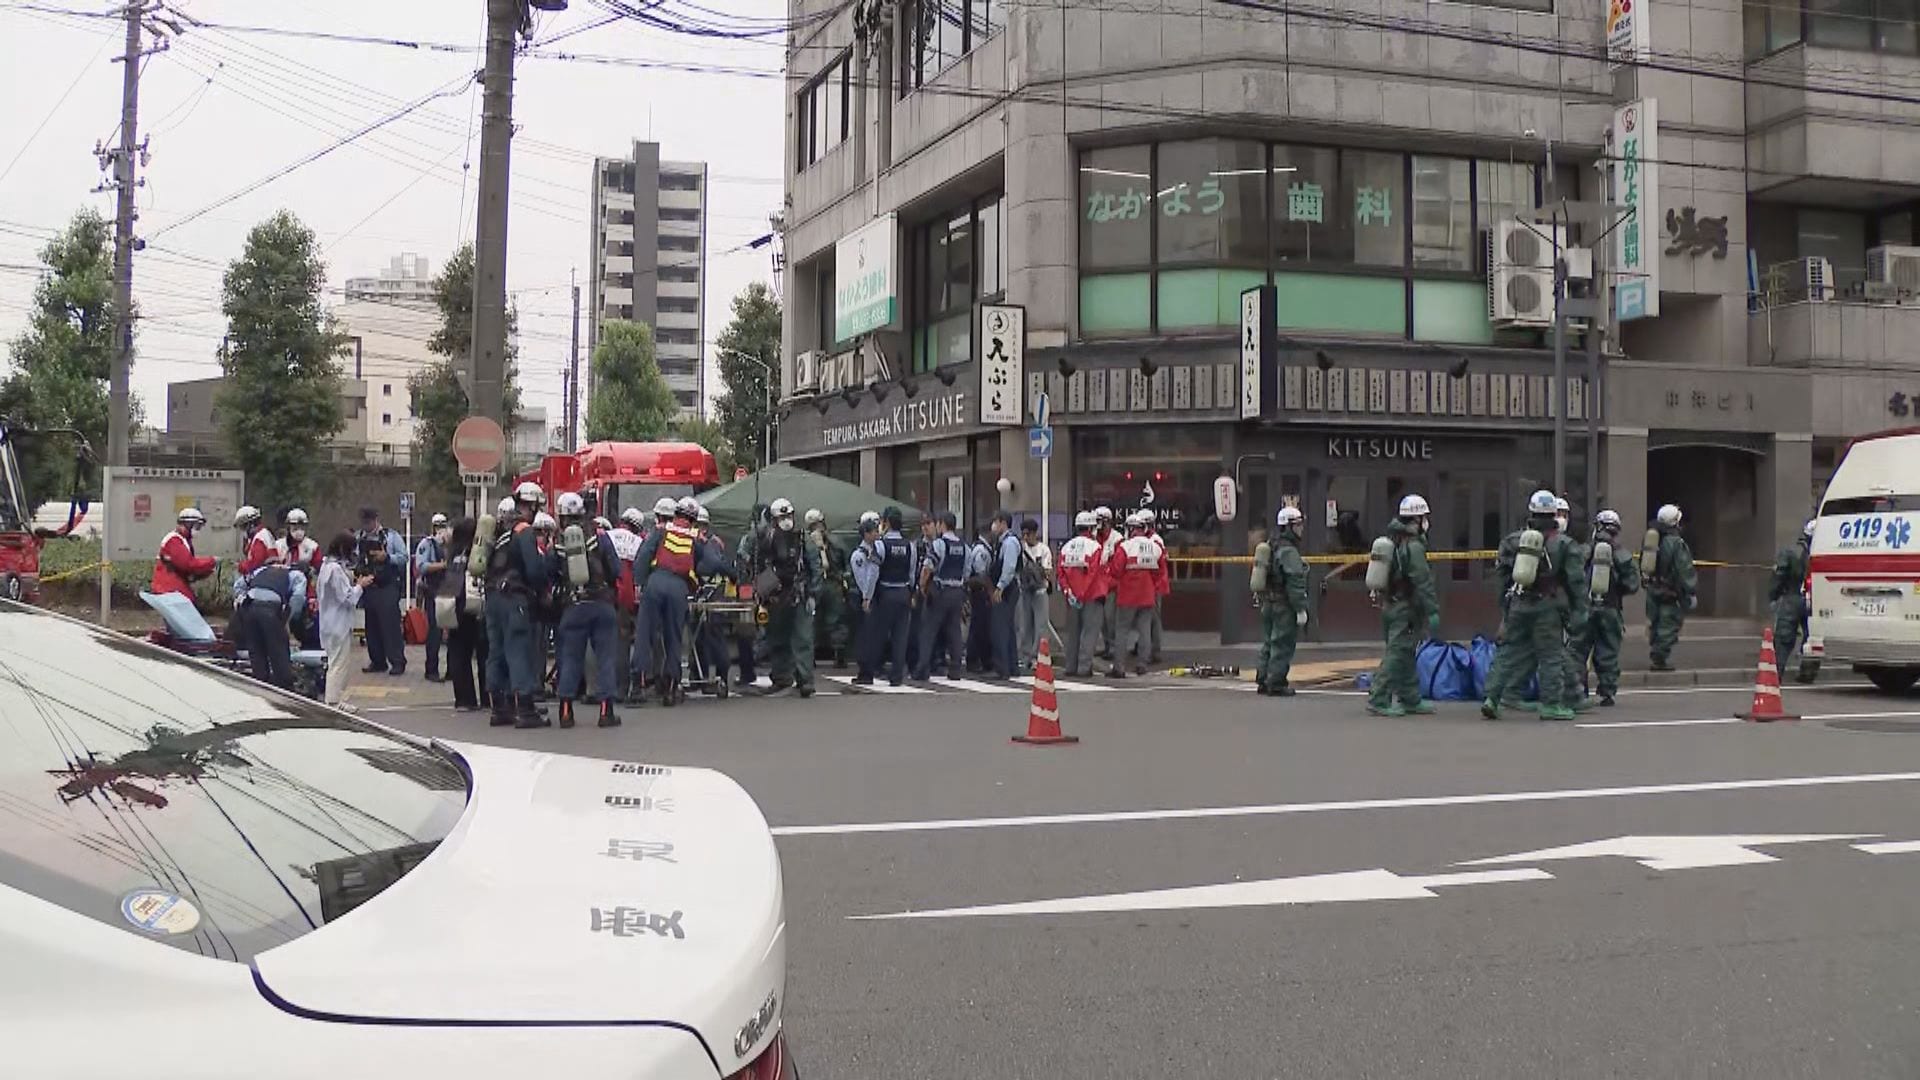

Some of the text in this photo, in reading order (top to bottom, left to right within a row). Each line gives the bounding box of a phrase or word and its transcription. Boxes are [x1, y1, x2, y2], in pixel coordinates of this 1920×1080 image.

[823, 393, 965, 446] TEMPURA SAKABA KITSUNE
[1327, 437, 1434, 460] KITSUNE
[1115, 508, 1180, 520] KITNE
